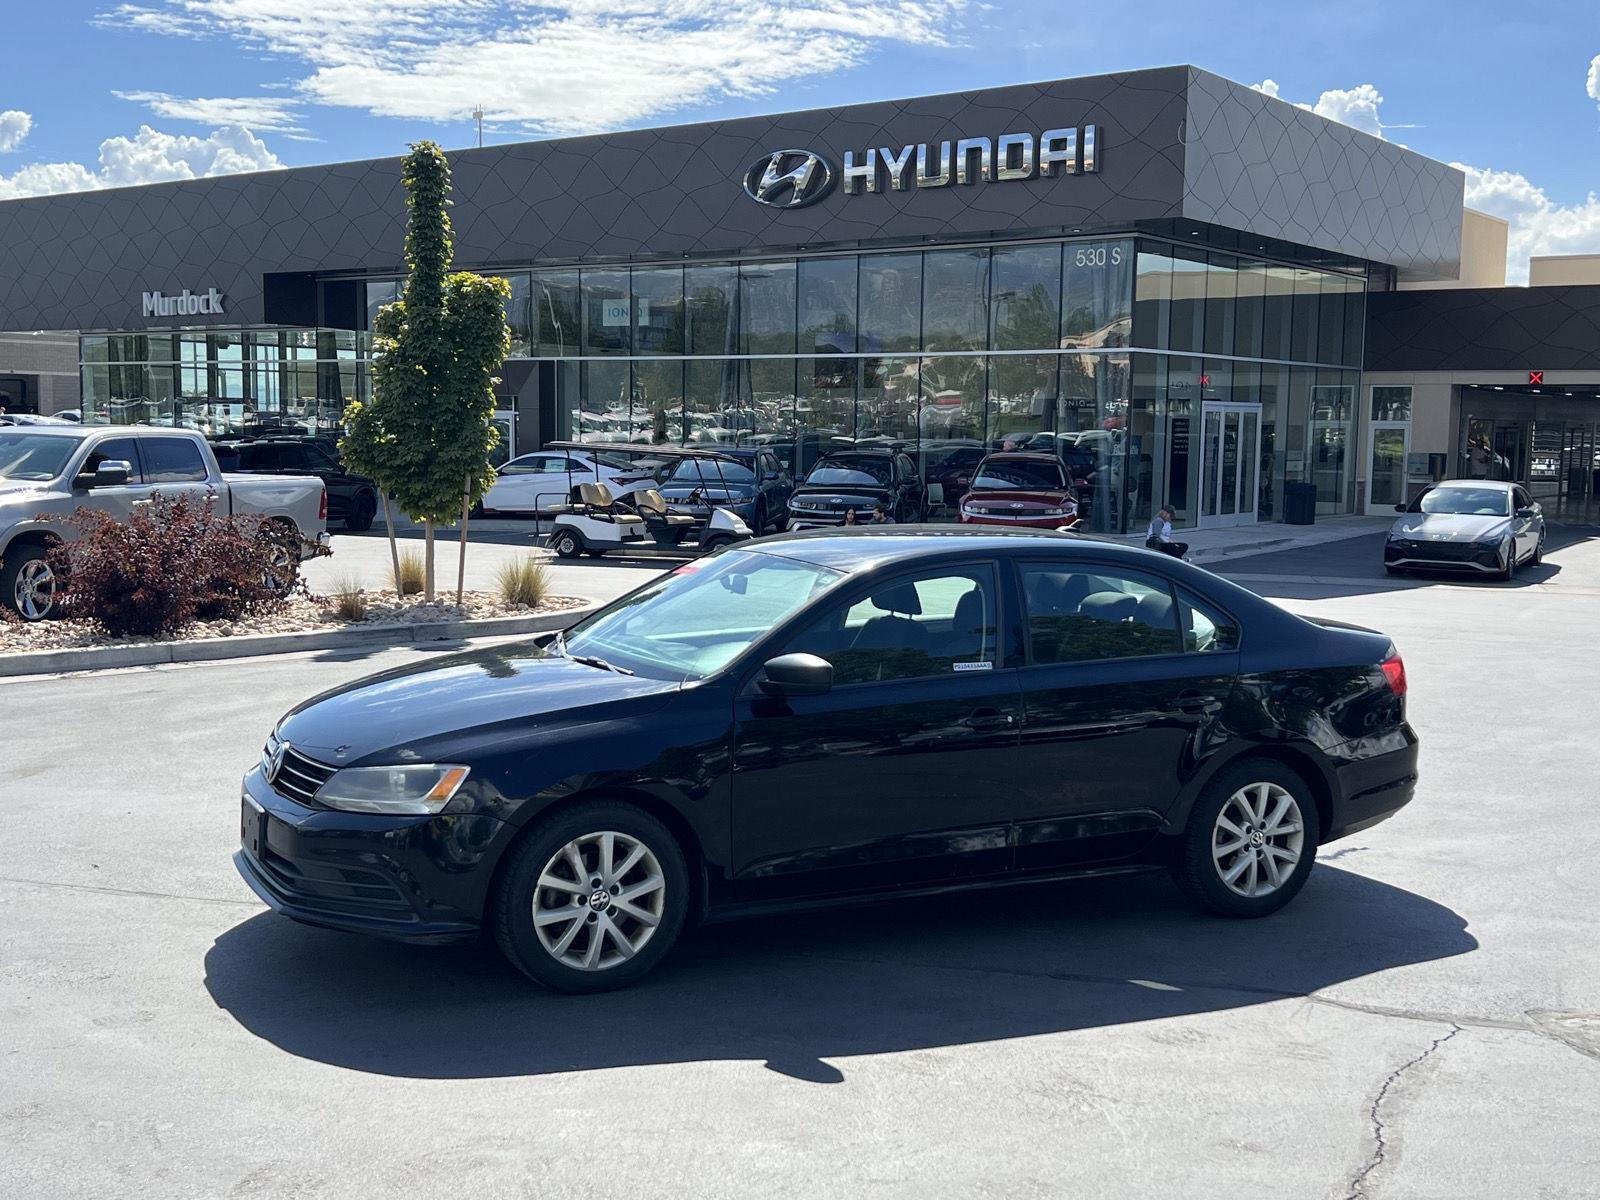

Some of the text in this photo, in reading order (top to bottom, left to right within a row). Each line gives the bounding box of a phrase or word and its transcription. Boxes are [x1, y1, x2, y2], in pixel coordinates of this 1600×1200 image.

[843, 124, 1096, 195] HYUNDAI
[1075, 247, 1121, 267] 530 S
[142, 288, 224, 316] Murdock
